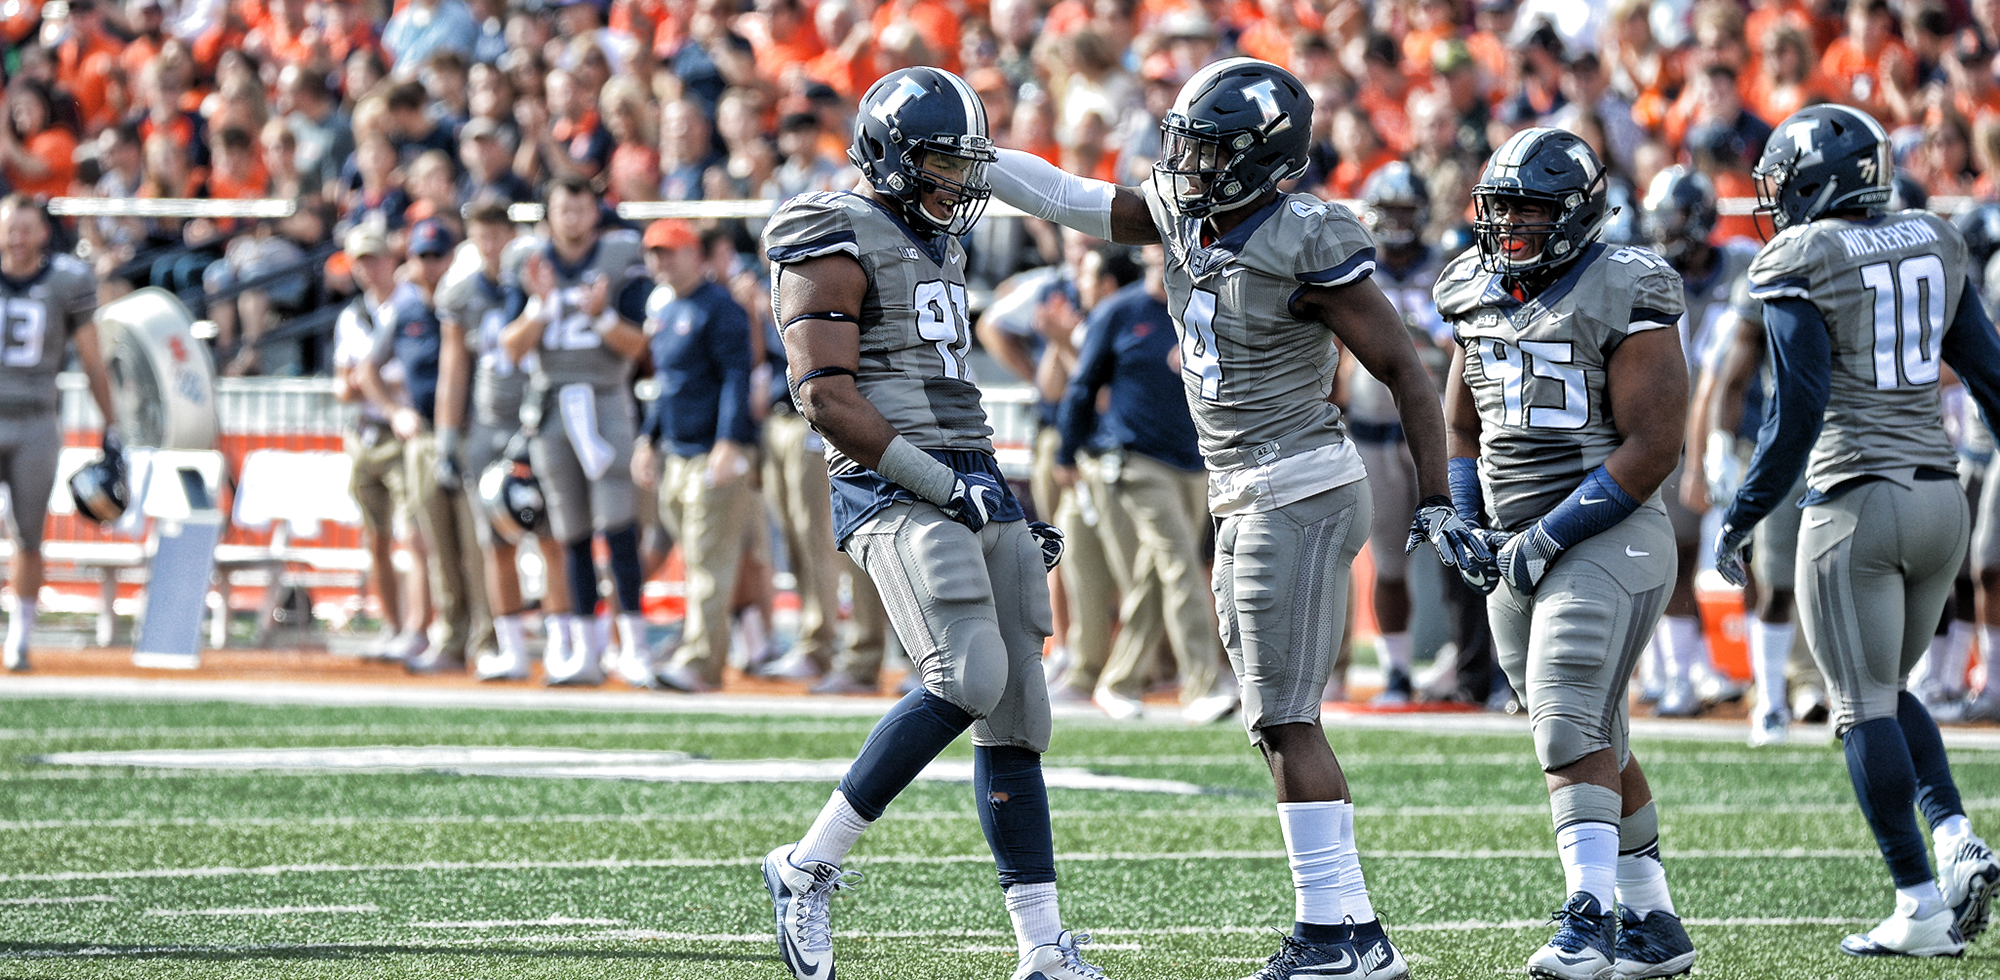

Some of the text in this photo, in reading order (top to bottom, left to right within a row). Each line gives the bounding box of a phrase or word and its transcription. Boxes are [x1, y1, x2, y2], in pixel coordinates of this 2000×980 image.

[936, 136, 955, 145] NIKE
[1838, 217, 1939, 257] NICKERSON
[0, 298, 47, 368] 3
[1182, 284, 1224, 402] 4
[1861, 255, 1945, 389] 10
[1478, 338, 1591, 430] 95
[1360, 940, 1389, 977] NIKE
